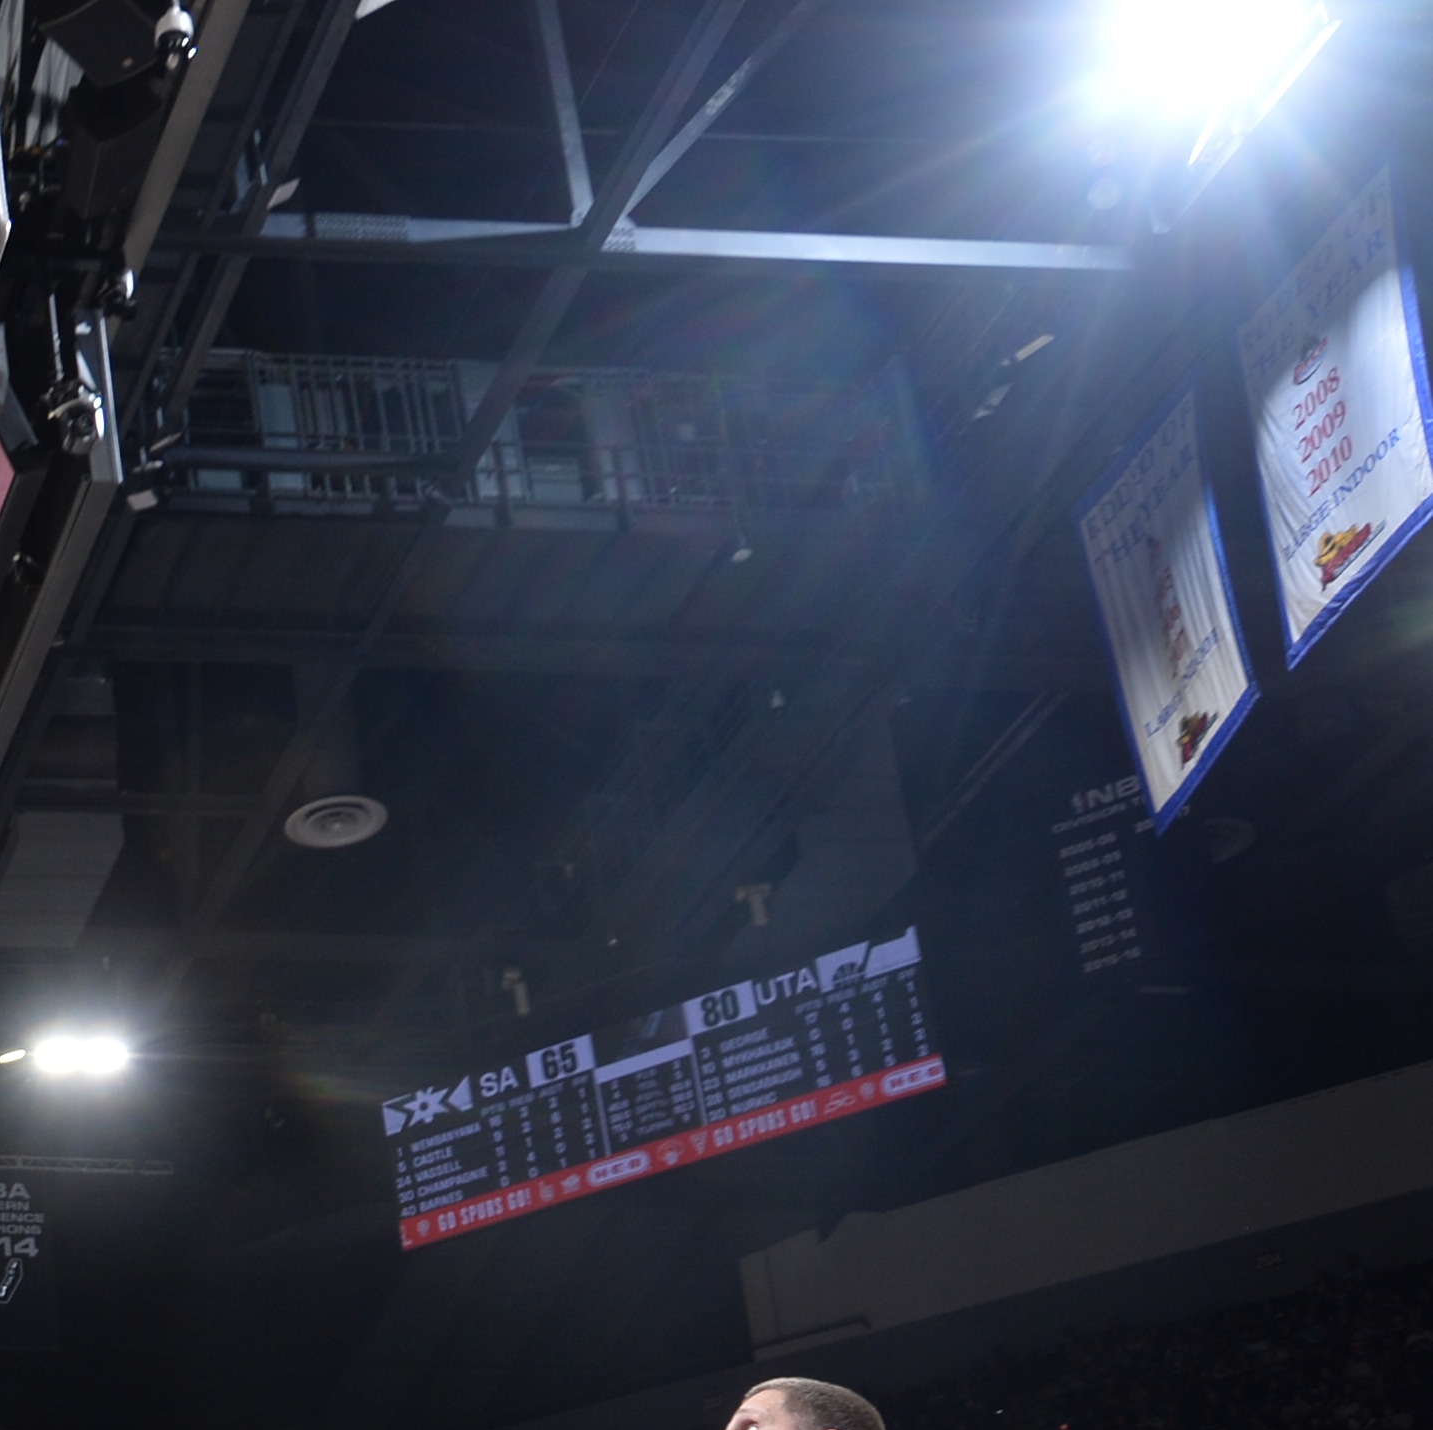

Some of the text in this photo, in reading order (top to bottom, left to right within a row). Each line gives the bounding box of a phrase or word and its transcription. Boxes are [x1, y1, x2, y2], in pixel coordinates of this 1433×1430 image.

[1293, 366, 1341, 431] 2008
[1298, 400, 1347, 464] 2009
[1306, 436, 1353, 498] 2010
[1332, 428, 1400, 508] INDOOR
[756, 966, 818, 1005] UTA
[700, 989, 740, 1027] 80
[540, 1042, 577, 1080] 65
[479, 1065, 519, 1098] SA
[438, 1212, 457, 1232] GO
[460, 1197, 504, 1225] SPURS
